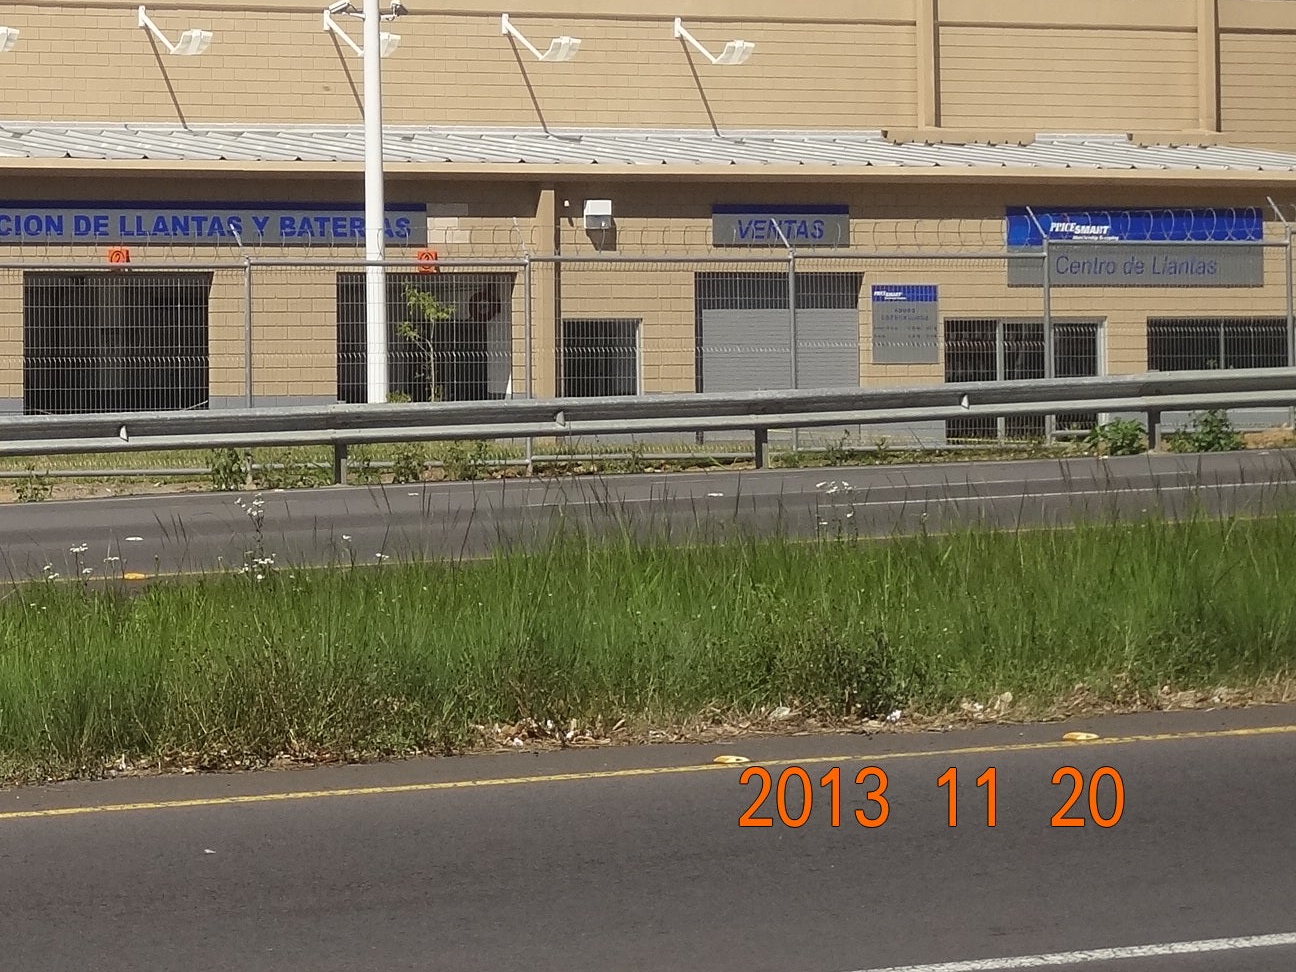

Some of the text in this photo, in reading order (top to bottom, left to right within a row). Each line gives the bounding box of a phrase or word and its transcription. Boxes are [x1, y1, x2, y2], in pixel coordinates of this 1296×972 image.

[74, 214, 109, 237] DE
[120, 215, 242, 238] LLANTAS
[252, 215, 270, 236] Y
[280, 216, 411, 239] BATERAS
[738, 219, 824, 239] VENTAS
[1056, 255, 1217, 275] Centro de Llantas
